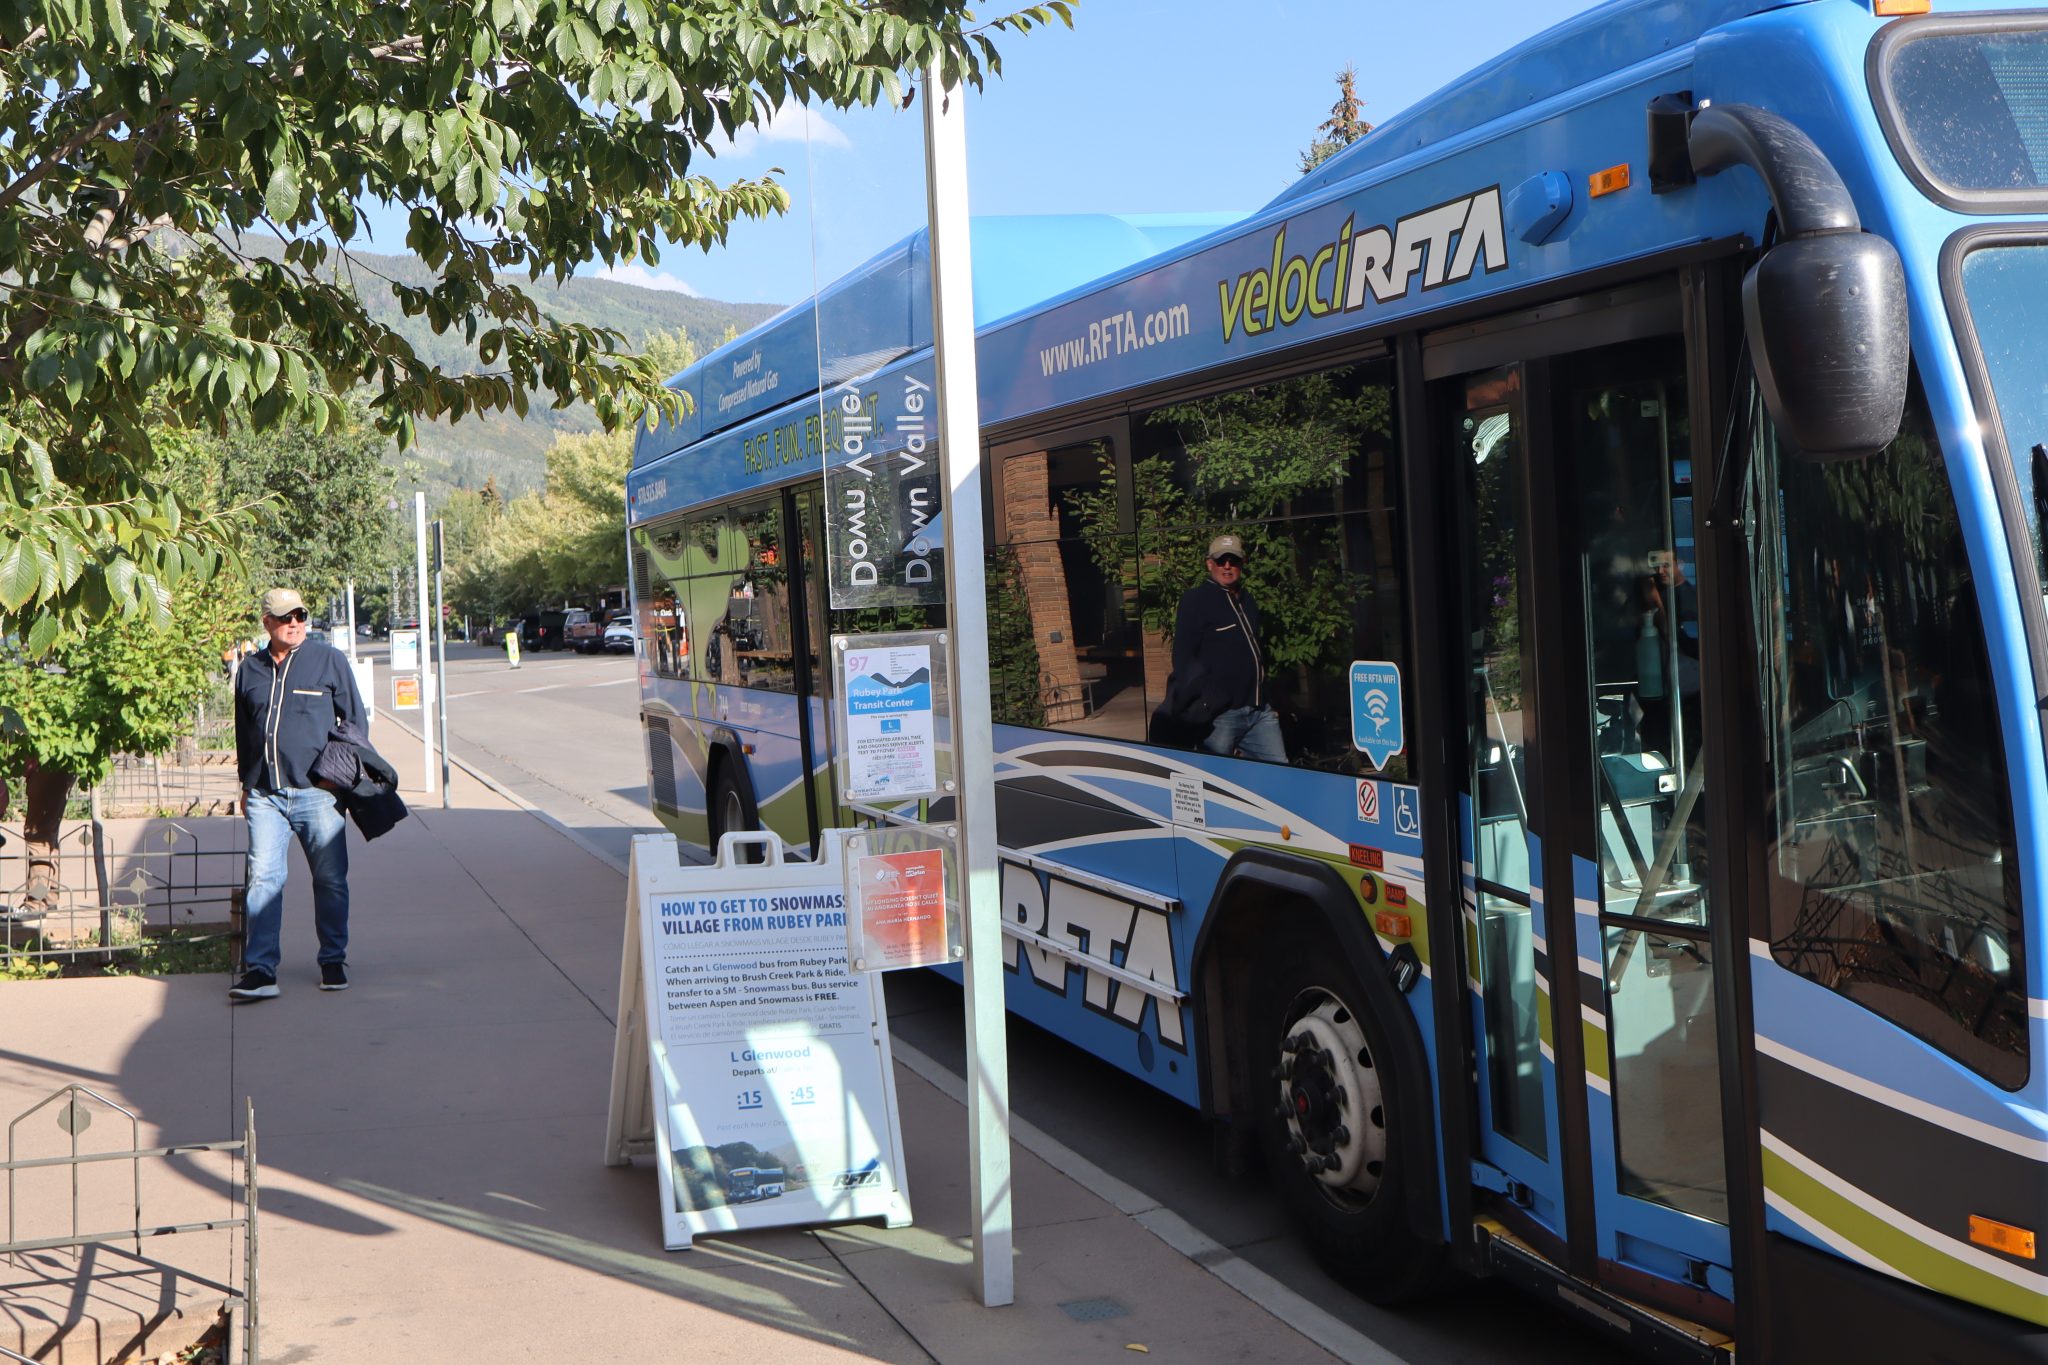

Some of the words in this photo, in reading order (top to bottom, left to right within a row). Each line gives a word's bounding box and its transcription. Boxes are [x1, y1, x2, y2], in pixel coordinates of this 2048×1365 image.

[1218, 182, 1509, 344] velociRFTA
[1040, 303, 1190, 377] www.RFTA.com
[733, 349, 754, 381] Powered
[754, 349, 762, 374] by
[719, 380, 747, 413] Compressed
[747, 371, 767, 400] Natural
[767, 370, 778, 390] Gas
[896, 375, 930, 476] Valley
[743, 430, 772, 475] FAST.
[774, 422, 803, 465] FUN.
[905, 487, 932, 584] Down
[848, 656, 868, 671] 97
[1354, 673, 1367, 683] FREE
[1368, 673, 1383, 683] RFTA
[1383, 674, 1396, 684] WIFI
[853, 688, 881, 697] Rubey
[882, 686, 903, 695] Park
[853, 701, 884, 709] Transit
[885, 699, 914, 708] Center
[1351, 847, 1381, 866] KNEELING
[1386, 885, 1405, 898] RAMP
[661, 901, 695, 917] HOW
[699, 900, 717, 915] TO
[720, 899, 746, 913] GET
[749, 898, 767, 912] TO
[662, 919, 720, 935] VILLAGE
[724, 916, 763, 932] FROM
[767, 914, 811, 930] RUBEY
[687, 941, 713, 949] LLEGAR
[721, 939, 761, 947] SNOWMASS
[763, 937, 790, 945] VILLAGE
[791, 936, 812, 944] DESDE
[665, 965, 690, 974] Catch
[713, 961, 757, 971] Glenwood
[777, 960, 797, 968] from
[799, 958, 826, 967] Rubey
[666, 977, 692, 986] When
[694, 976, 728, 984] arriving
[742, 973, 766, 982] Brush
[769, 971, 793, 980] Creek
[795, 970, 815, 978] Park
[825, 969, 846, 977] Ride,
[667, 989, 701, 998] transfer
[723, 986, 736, 994] SM
[744, 985, 789, 993] Snowmass
[829, 980, 858, 988] service
[668, 1002, 707, 1010] between
[710, 1000, 737, 1008] Aspen
[739, 997, 756, 1005] and
[758, 996, 804, 1004] Snowmass
[814, 992, 839, 1001] FREE.
[731, 1051, 738, 1062] L
[742, 1046, 810, 1062] Glenwood
[732, 1068, 764, 1078] Departs
[737, 1090, 762, 1106] :15
[790, 1086, 815, 1101] :45
[732, 1122, 748, 1130] each
[750, 1121, 767, 1129] hour
[832, 1171, 881, 1187] RFTA
